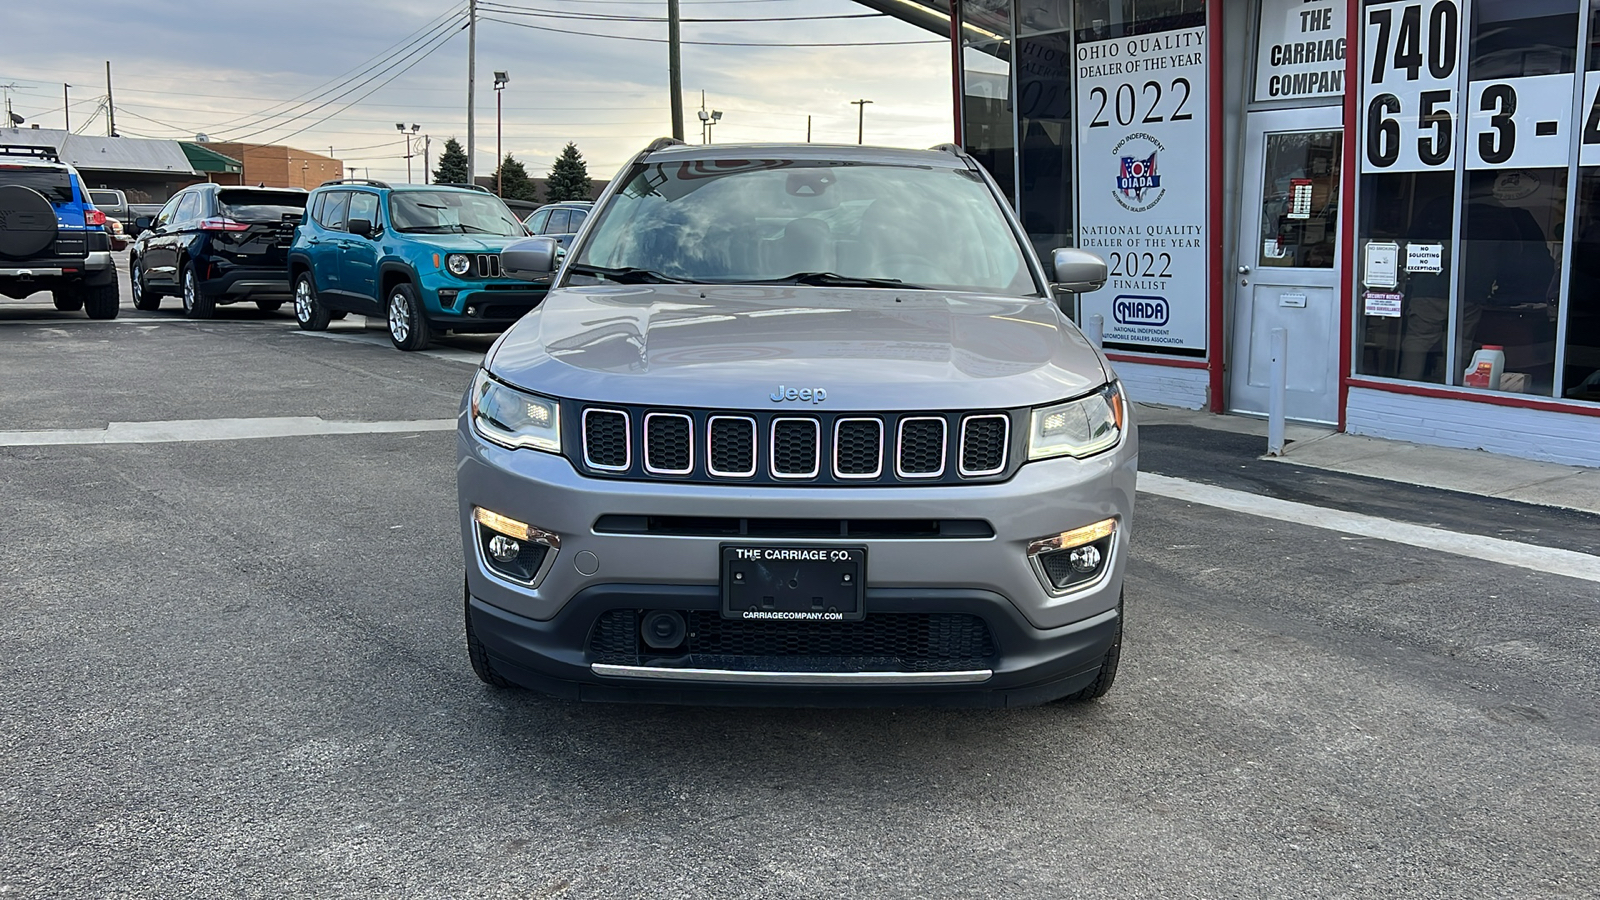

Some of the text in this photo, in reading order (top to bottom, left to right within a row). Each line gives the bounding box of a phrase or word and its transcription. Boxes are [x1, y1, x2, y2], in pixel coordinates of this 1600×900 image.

[1300, 8, 1332, 32] THE
[1078, 31, 1205, 61] OHIO QUALITY
[1369, 0, 1457, 84] 740
[1080, 62, 1122, 78] DEALER
[1125, 59, 1140, 74] OF
[1143, 57, 1167, 70] THE
[1170, 52, 1203, 68] YEAR
[1269, 69, 1346, 96] COMPAN
[1089, 77, 1193, 128] 2022
[1112, 132, 1165, 155] OHIO INDEPENDENT
[1121, 176, 1153, 188] OIADA
[1081, 225, 1203, 237] NATIONAL QUALITY
[1083, 238, 1201, 248] DEALER OF THE YEAR
[1109, 251, 1172, 278] 2022
[1113, 280, 1167, 290] FINALIST
[1117, 301, 1164, 320] NIADA
[1113, 326, 1170, 336] NATIONAL INDEPENDENT
[1130, 334, 1150, 342] DEALERS
[1150, 336, 1184, 344] ASSOCIATION
[769, 385, 828, 405] Jeep
[736, 549, 852, 561] THE CARRIAGE CO.
[743, 611, 843, 620] CARRIAGECOMPANY.COM
